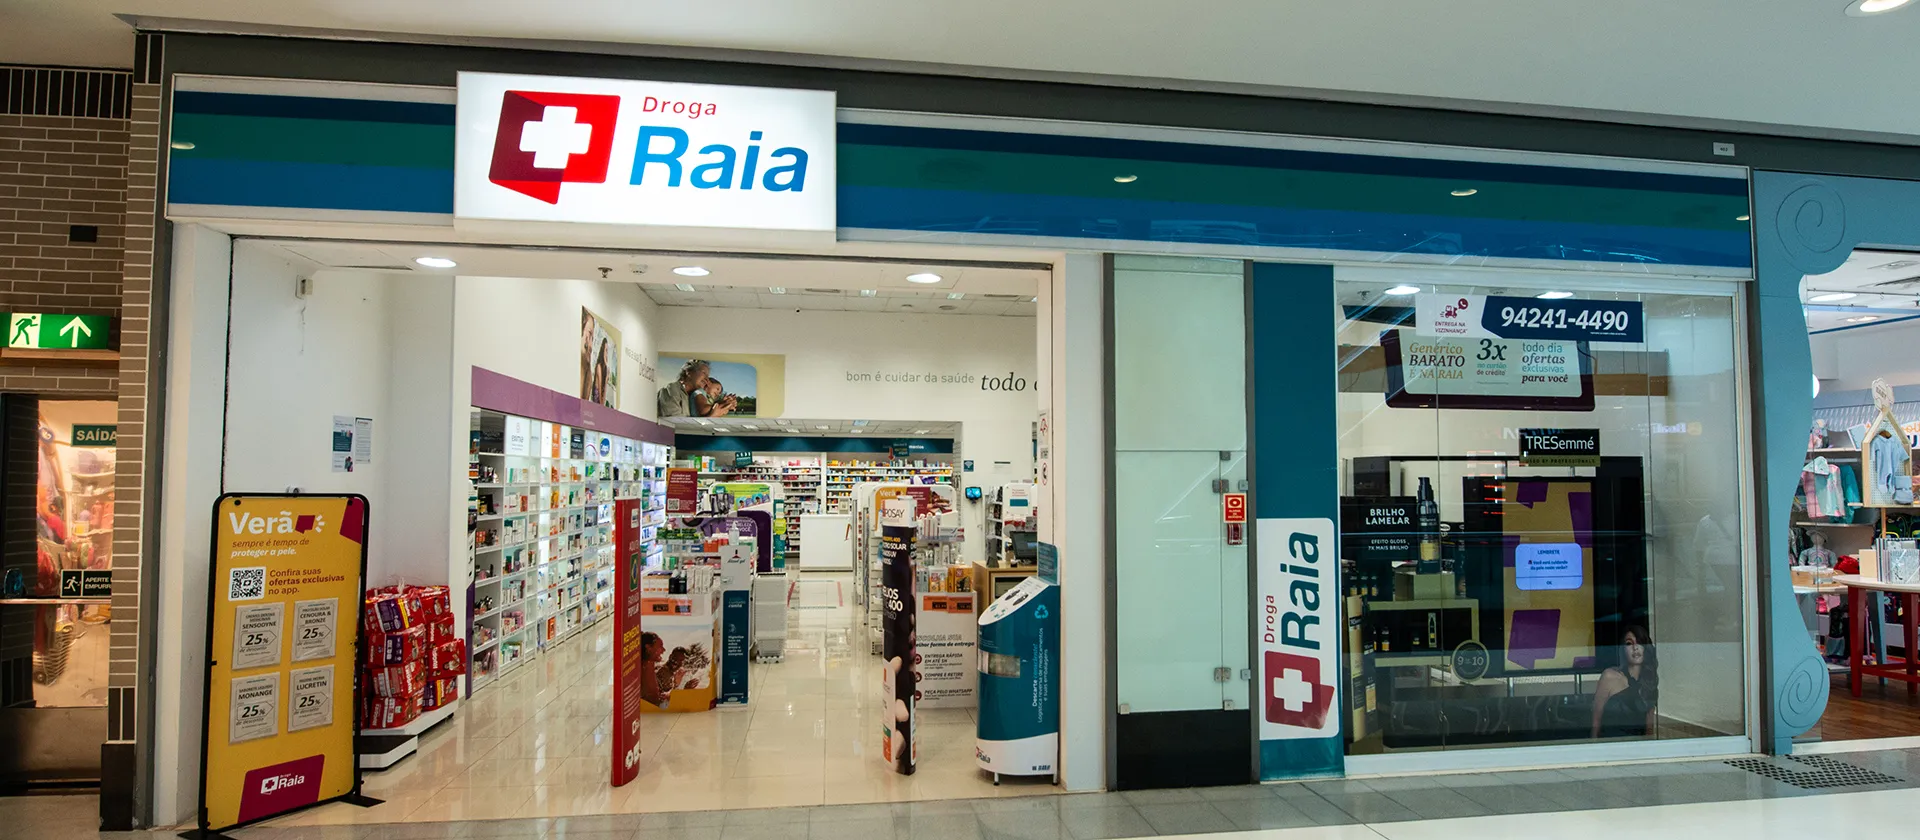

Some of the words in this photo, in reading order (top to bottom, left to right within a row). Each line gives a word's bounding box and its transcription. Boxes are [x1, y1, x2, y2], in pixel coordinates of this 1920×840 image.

[643, 97, 717, 119] Droga
[629, 126, 809, 192] Raia
[1500, 306, 1629, 331] 94241-4490
[1409, 342, 1463, 354] Genérico
[1476, 338, 1507, 361] 3x
[1522, 342, 1545, 353] todo
[1547, 342, 1562, 353] dia
[1409, 354, 1465, 367] BARATO
[1522, 353, 1565, 365] ofertas
[1419, 369, 1435, 379] NA
[1437, 369, 1463, 380] RAIA
[1522, 364, 1565, 373] exclusivas
[846, 371, 871, 381] bom
[875, 371, 881, 381] é
[885, 371, 921, 382] cuidar
[924, 373, 937, 383] da
[941, 373, 975, 384] saúde
[980, 371, 1026, 391] todo
[1521, 375, 1546, 384] para
[1547, 374, 1569, 383] você
[1525, 436, 1594, 450] TRESemmé
[1370, 508, 1405, 517] BRILHO
[1365, 517, 1410, 525] LAMELAR
[232, 540, 265, 548] sempre
[273, 539, 298, 548] tempo
[231, 549, 268, 558] proteger
[277, 548, 297, 556] pele.
[270, 569, 301, 578] Confira
[302, 568, 322, 576] suas
[269, 575, 300, 586] ofertas
[302, 574, 345, 584] exclusivas
[280, 586, 300, 597] app.
[1280, 532, 1321, 650] Raia
[242, 621, 276, 629] SENSODYNE
[1264, 595, 1277, 644] Droga
[245, 633, 269, 646] 25%
[302, 628, 324, 640] 25%
[1457, 656, 1464, 665] 9
[1471, 656, 1484, 666] 10
[296, 681, 327, 691] LUCRETIN
[238, 689, 273, 700] MONANGE
[298, 695, 320, 708] 25%
[241, 705, 265, 718] 25%
[278, 775, 305, 789] Raia
